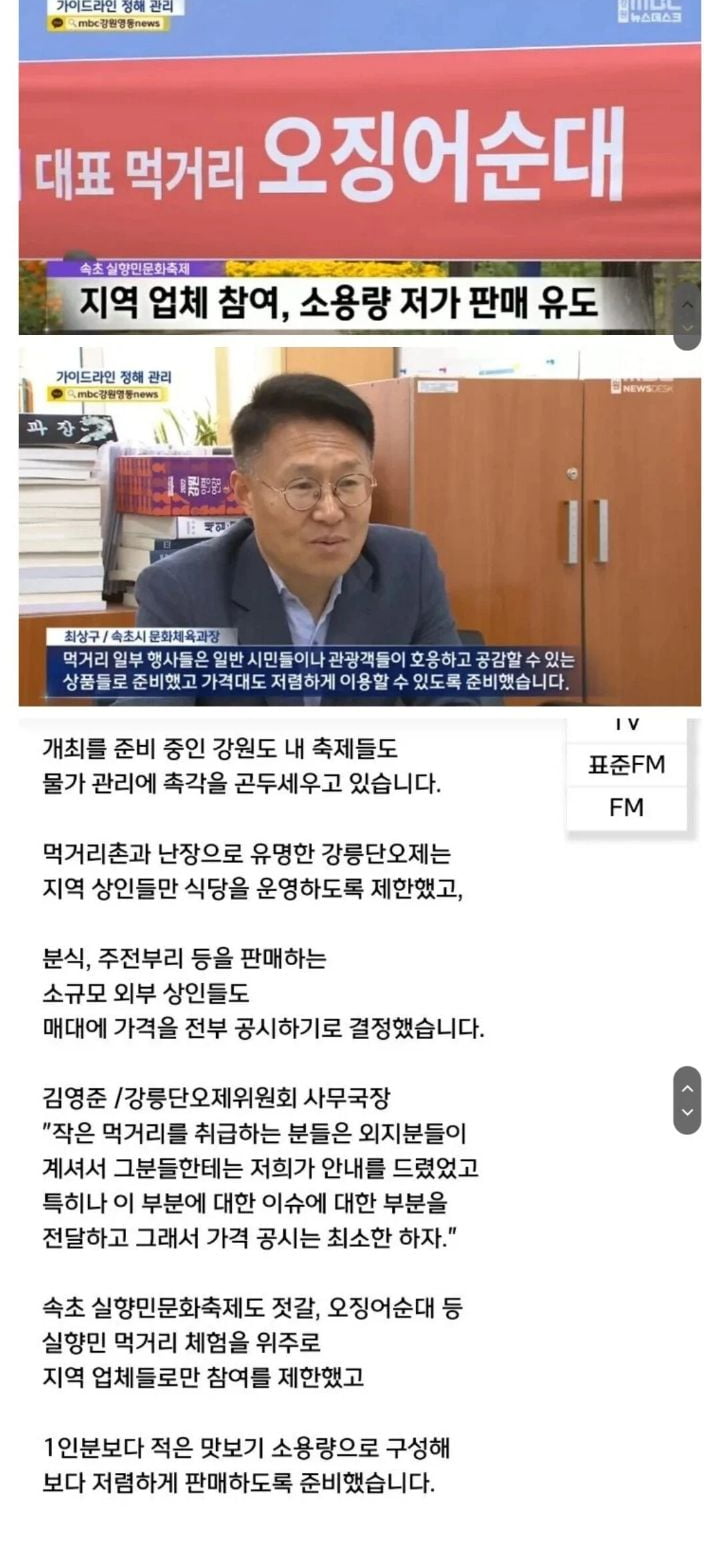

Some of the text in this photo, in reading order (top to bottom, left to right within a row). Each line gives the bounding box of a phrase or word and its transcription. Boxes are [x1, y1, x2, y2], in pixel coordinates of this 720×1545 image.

[36, 148, 114, 200] 대표
[127, 146, 243, 200] 먹거리
[259, 106, 624, 203] 오징어순대
